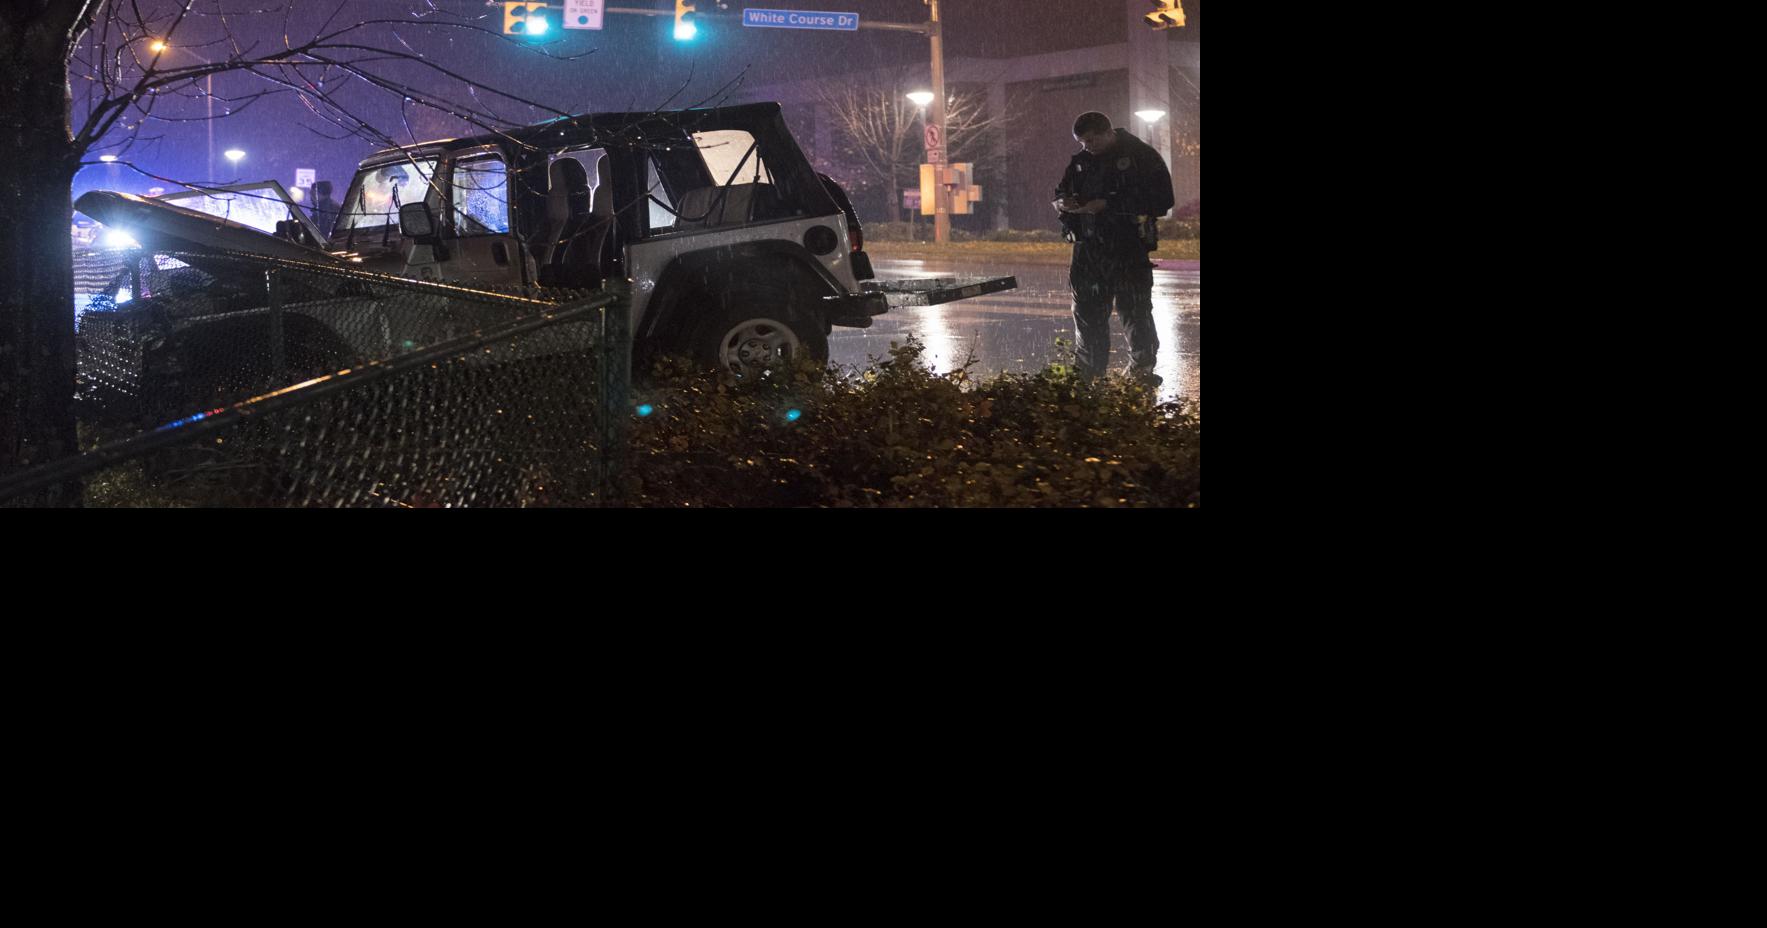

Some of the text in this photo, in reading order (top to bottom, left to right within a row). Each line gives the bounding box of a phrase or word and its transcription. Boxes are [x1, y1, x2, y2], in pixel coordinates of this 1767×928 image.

[749, 11, 853, 26] White Course Dr
